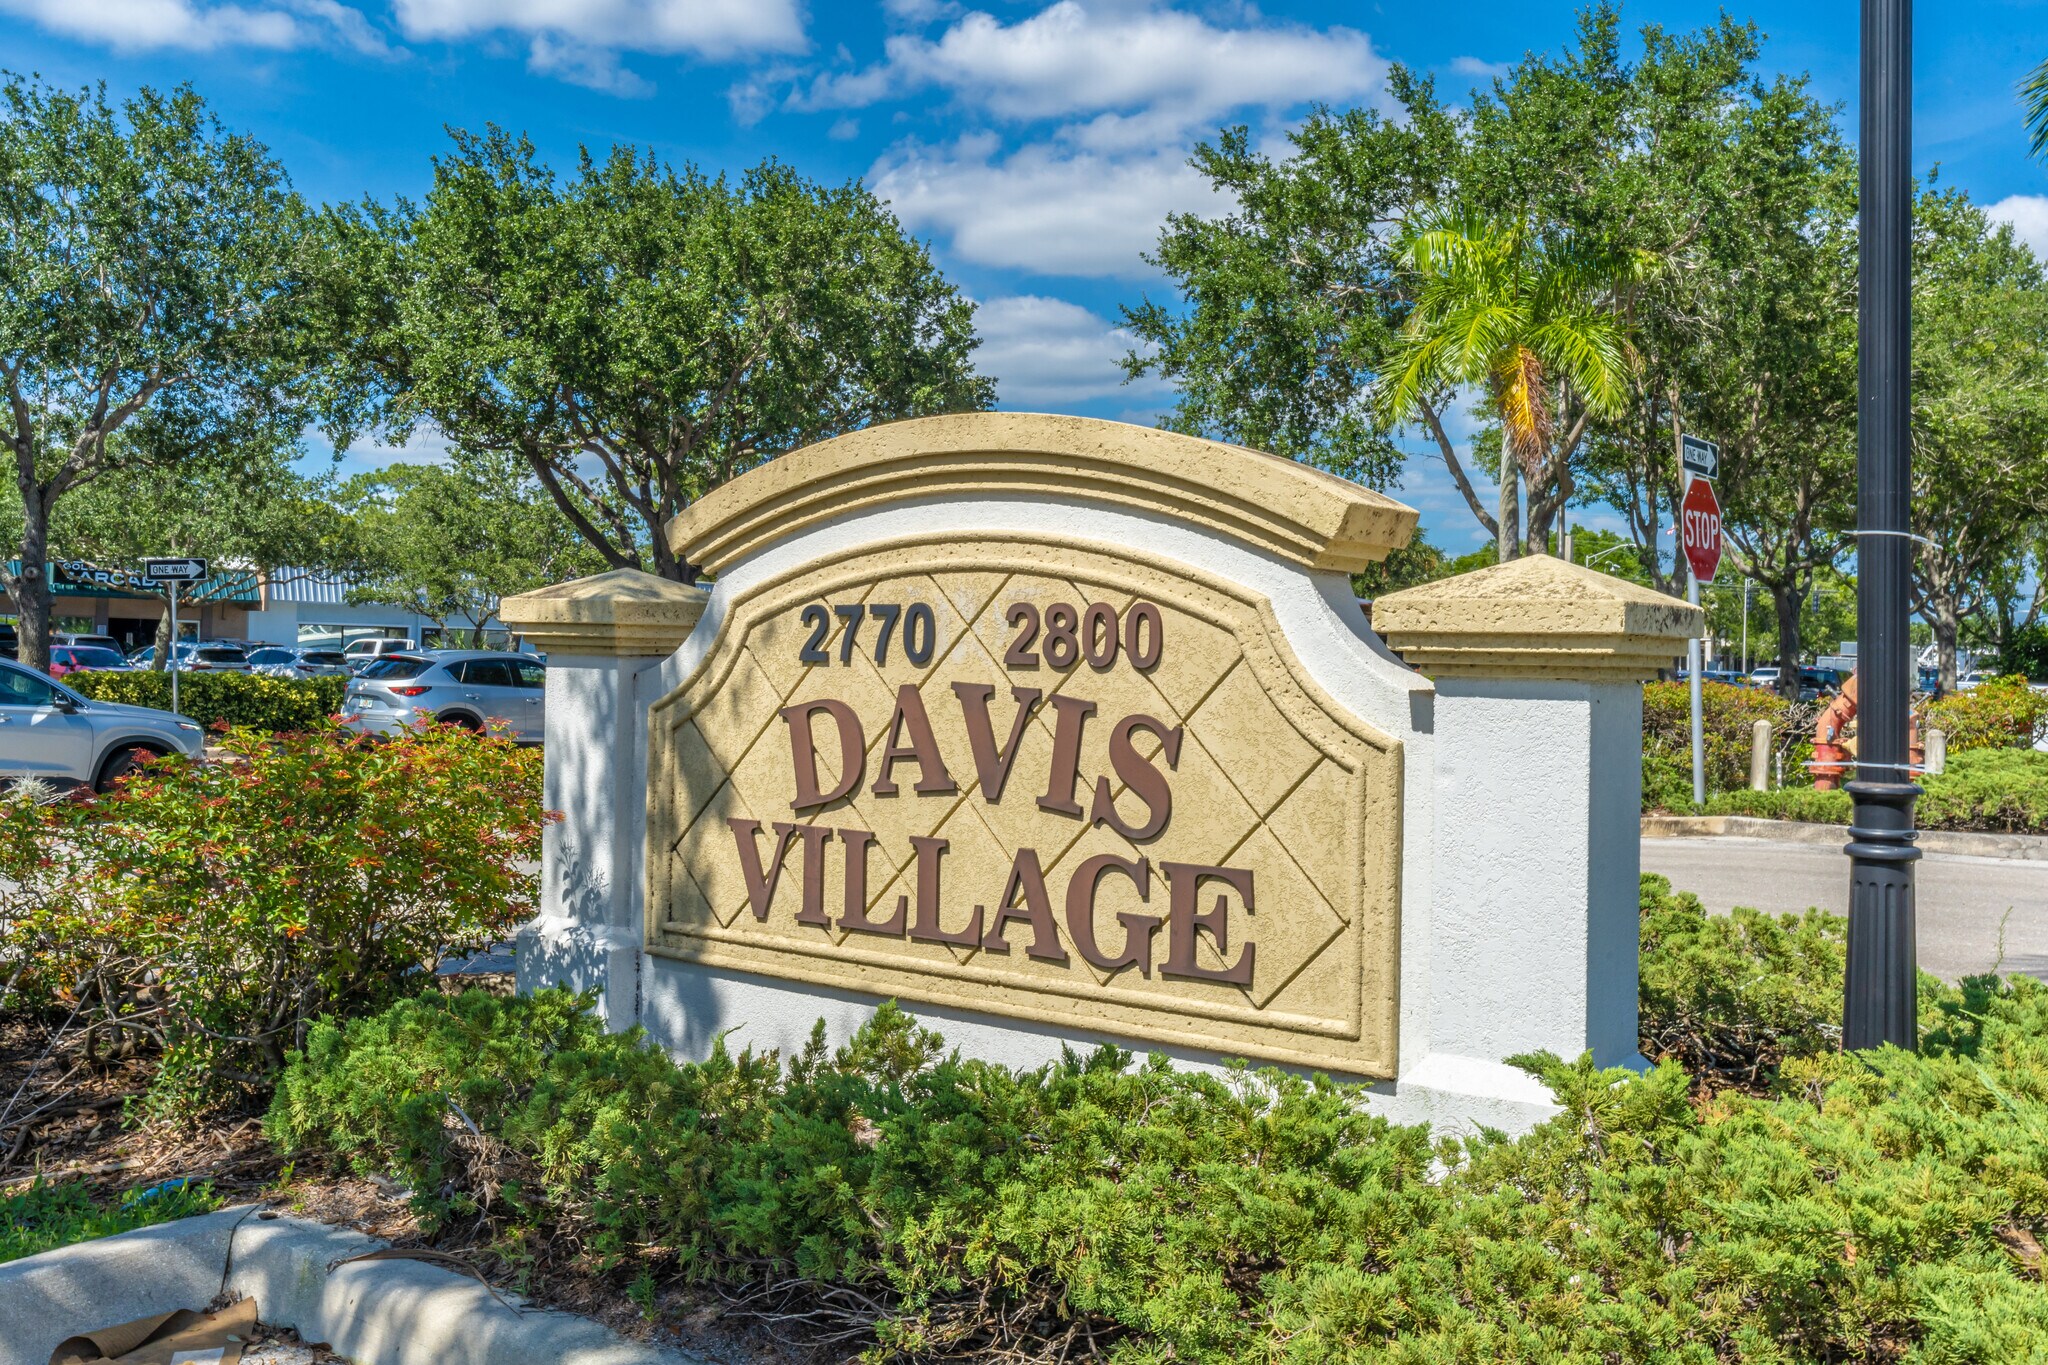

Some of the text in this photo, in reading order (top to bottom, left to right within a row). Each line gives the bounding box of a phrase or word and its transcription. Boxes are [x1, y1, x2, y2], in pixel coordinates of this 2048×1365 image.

[1685, 446, 1707, 465] ONE WAY
[1686, 509, 1718, 549] STOP
[152, 565, 169, 574] ONE
[171, 565, 188, 574] WAY
[800, 601, 1163, 672] 2770 2800
[779, 681, 1183, 842] DAVIS
[726, 817, 1255, 986] VILLAGE
